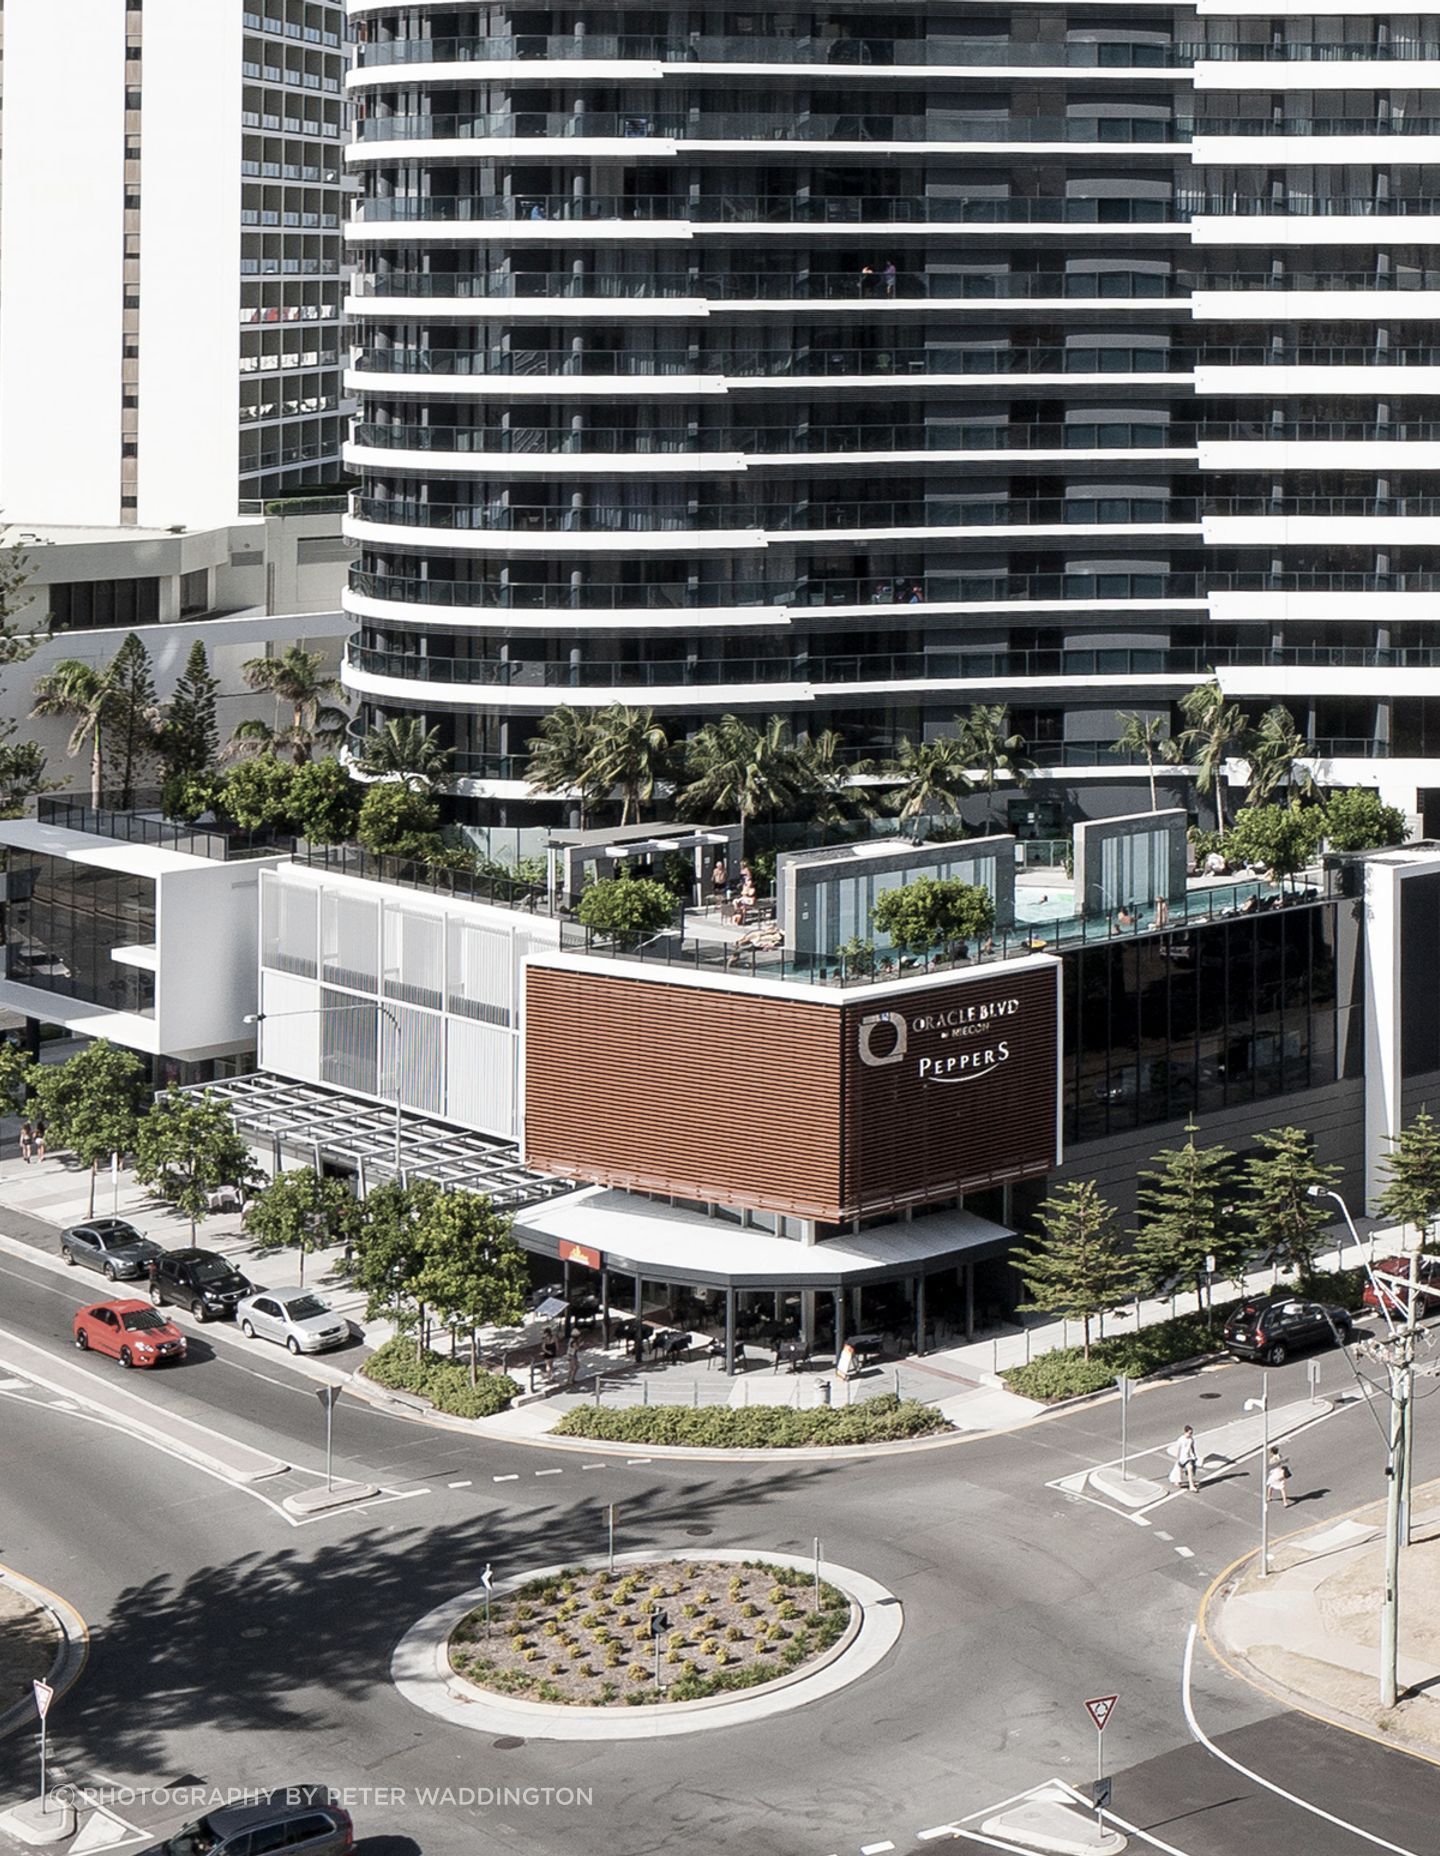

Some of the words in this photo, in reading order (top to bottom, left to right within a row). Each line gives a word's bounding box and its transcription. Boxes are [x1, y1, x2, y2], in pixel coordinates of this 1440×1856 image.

[912, 1007, 976, 1032] ORACLE
[979, 999, 1019, 1020] BLVD
[919, 1041, 1010, 1078] PEPPERS
